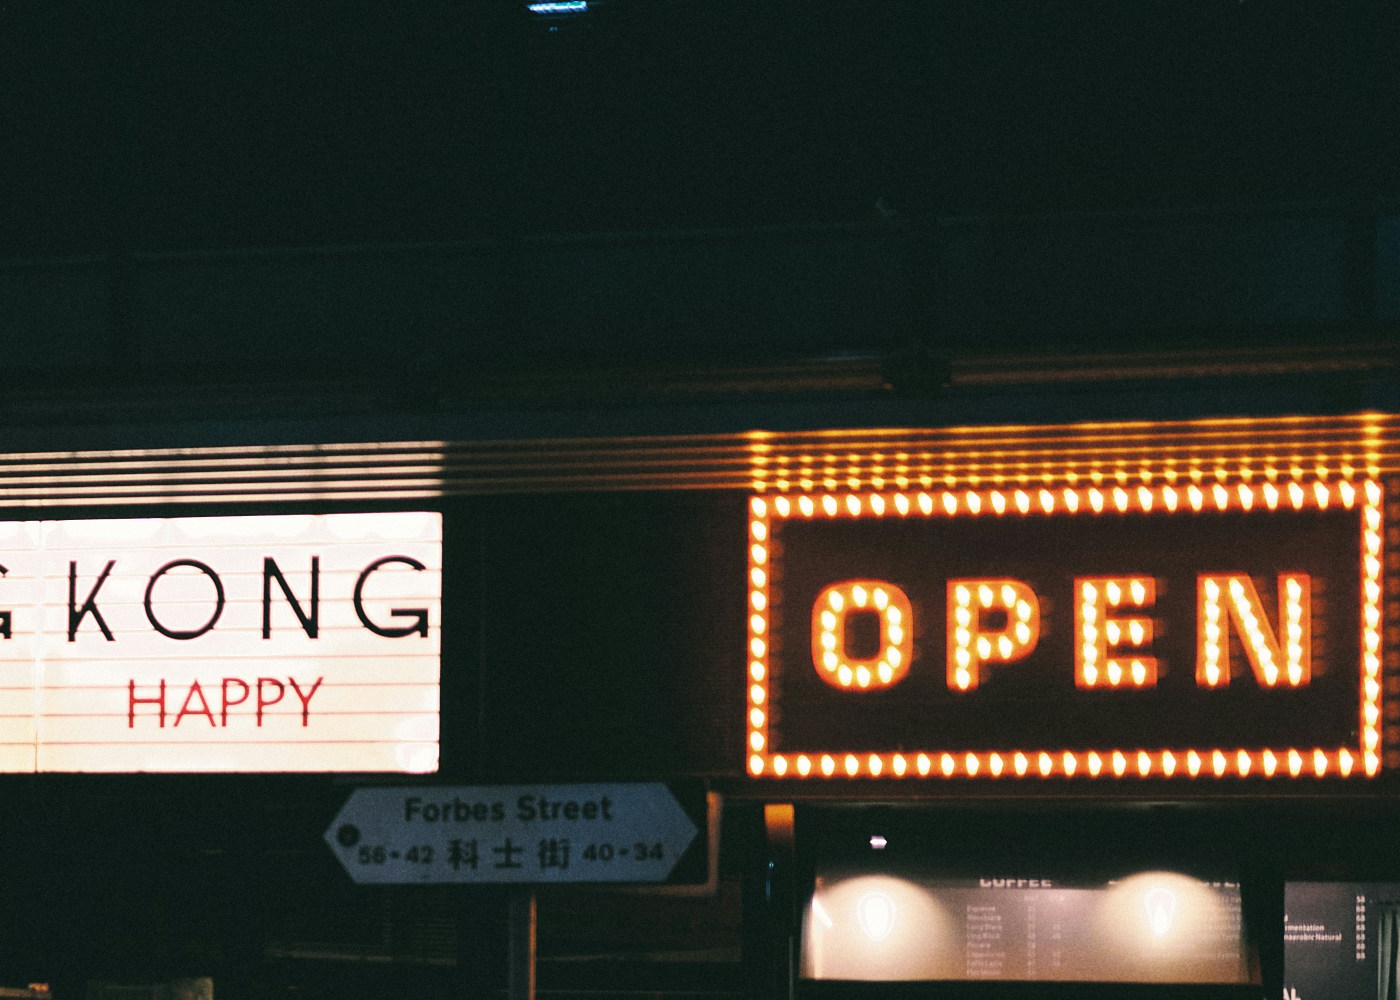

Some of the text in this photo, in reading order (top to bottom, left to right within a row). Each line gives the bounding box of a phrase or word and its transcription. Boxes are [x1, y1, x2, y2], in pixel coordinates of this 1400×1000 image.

[66, 555, 429, 641] KONG
[811, 572, 1312, 692] OPEN
[129, 676, 324, 728] HAPPY
[404, 794, 613, 822] Forbes Street
[447, 837, 571, 870] 科士街
